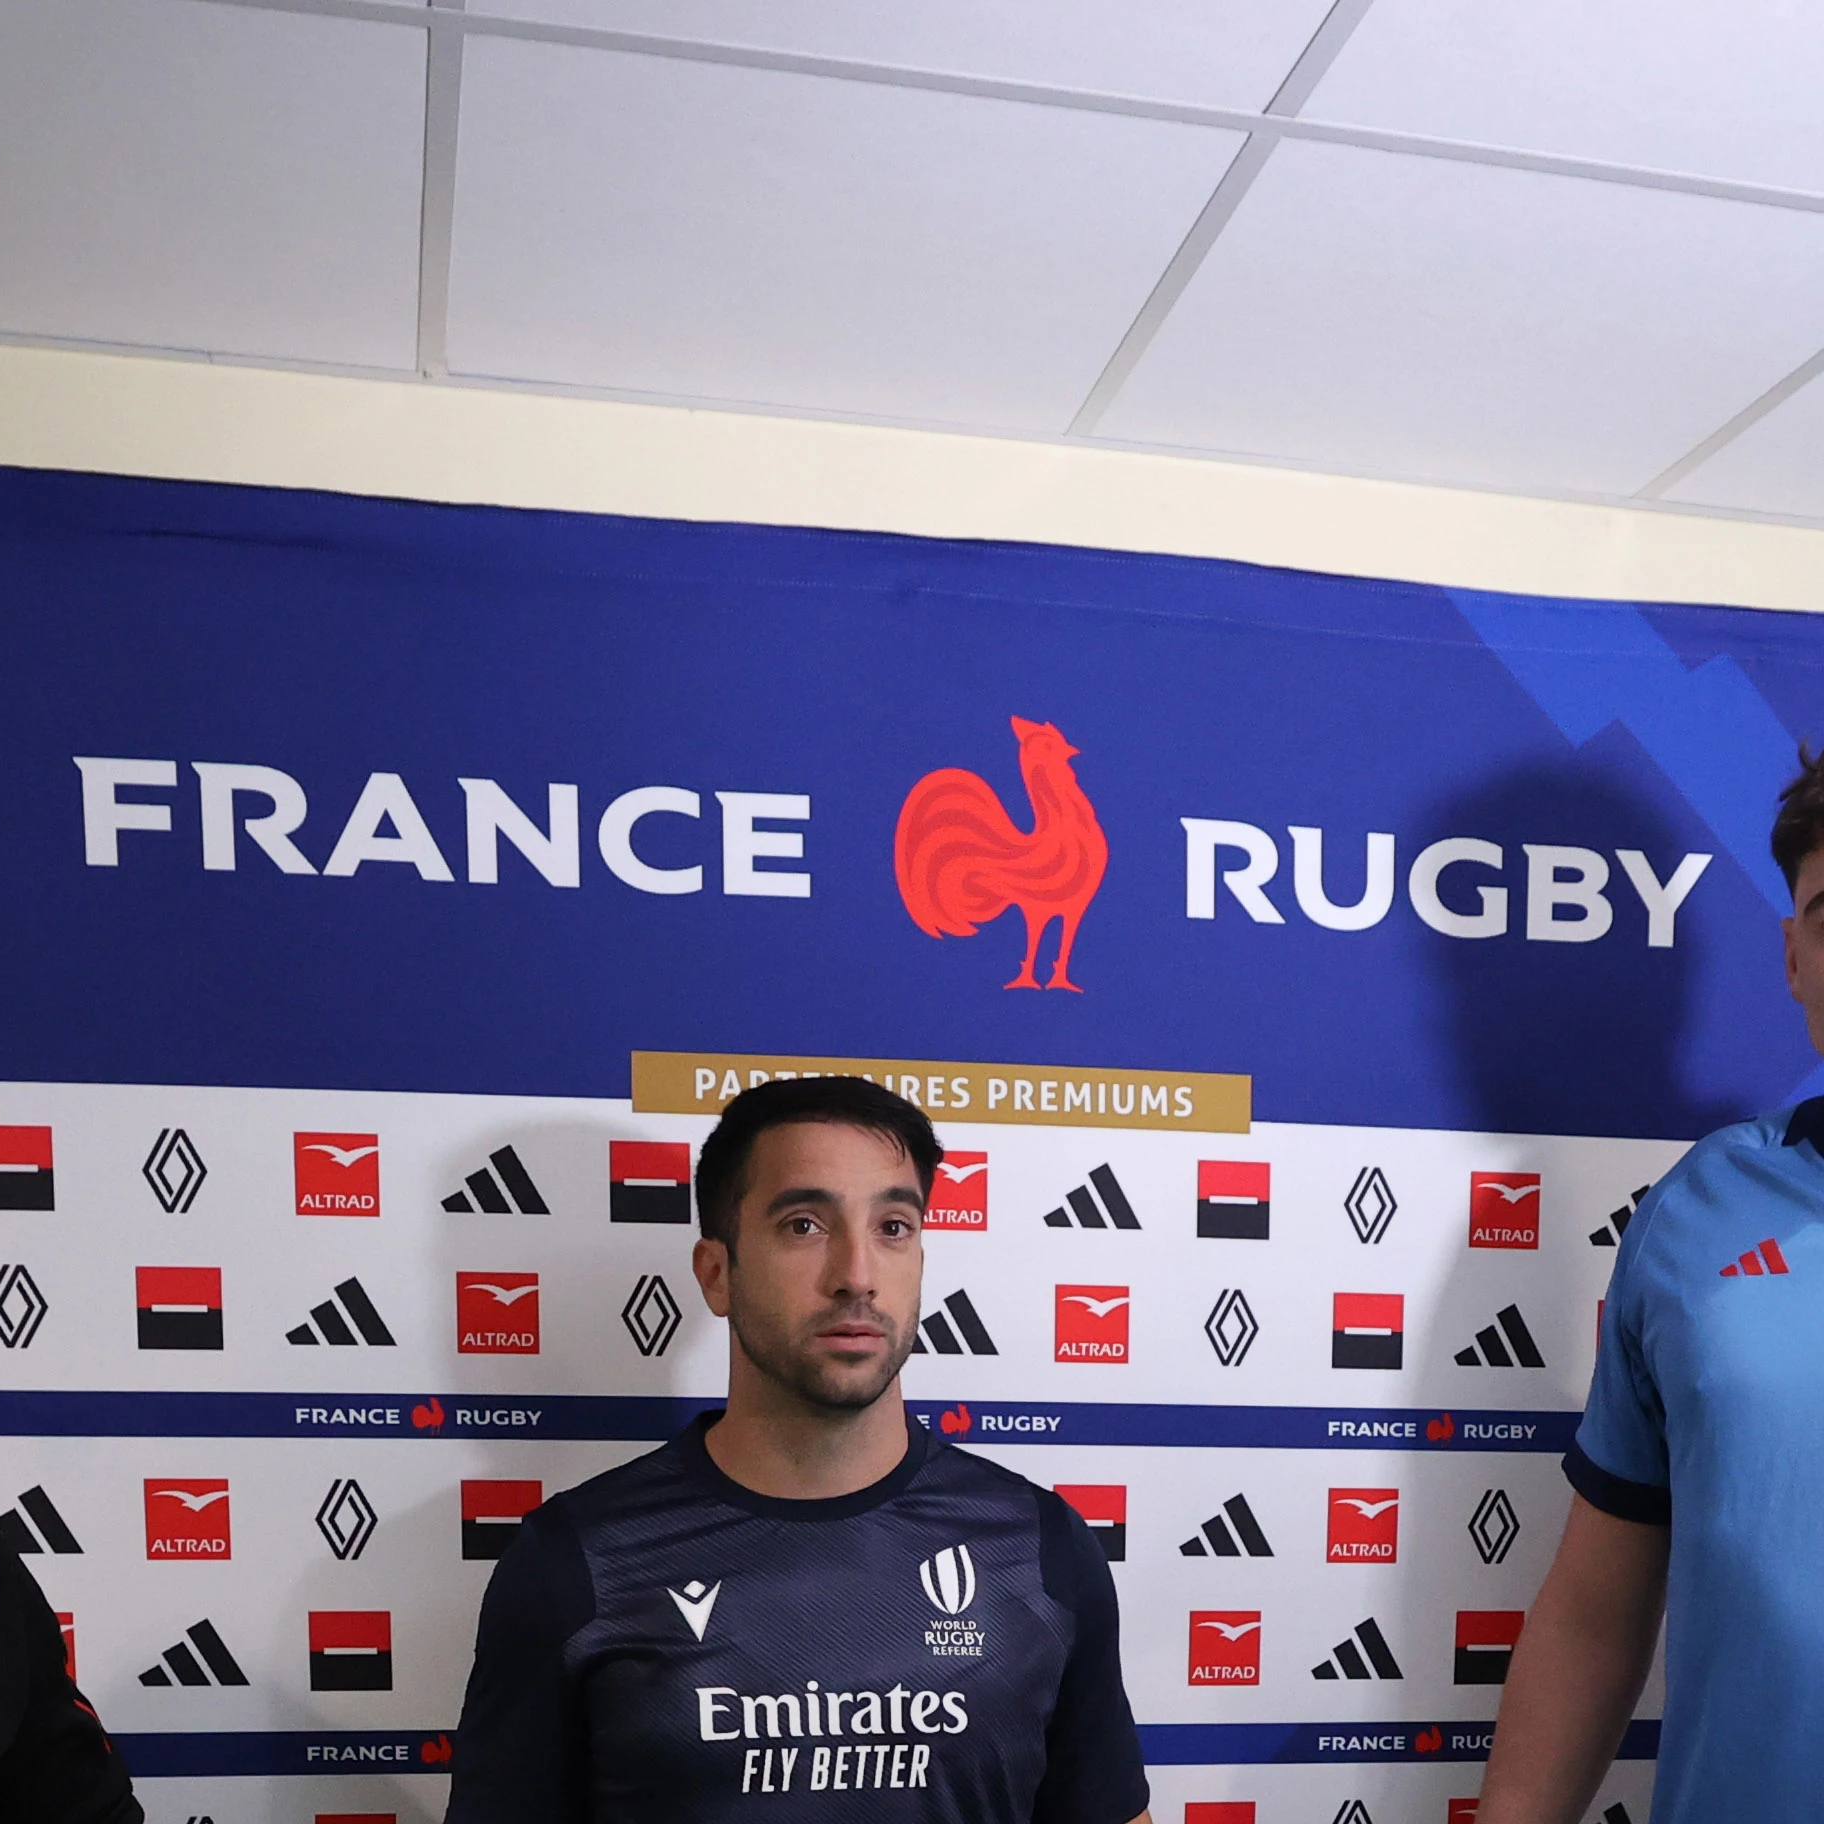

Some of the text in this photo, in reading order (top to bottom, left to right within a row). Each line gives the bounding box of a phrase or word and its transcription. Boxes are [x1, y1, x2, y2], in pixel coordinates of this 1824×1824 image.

[72, 756, 1714, 948] FRANCE RUGBY
[694, 1067, 1194, 1118] PAIRES PREMIUMS
[299, 1193, 375, 1209] ALTRAD
[1471, 1225, 1535, 1244] ALTRAD
[462, 1332, 535, 1347] ALTRAD
[1058, 1342, 1125, 1357] ALTRAD
[295, 1408, 542, 1426] FRANCE RUGBY
[981, 1415, 1062, 1432] RUGBY
[1328, 1421, 1537, 1439] FRANCE RUGBY
[150, 1538, 226, 1553] ALTRAD
[1329, 1543, 1393, 1557] ALTRAD
[929, 1620, 977, 1630] WORLD
[924, 1631, 986, 1646] RUGBY
[932, 1646, 983, 1657] REFEREE
[1191, 1665, 1256, 1681] ALTRAD
[694, 1680, 969, 1742] Emirates
[1318, 1734, 1495, 1751] FRANCE RUG
[307, 1745, 409, 1761] FRANCE
[741, 1744, 931, 1793] FLY BETTER
